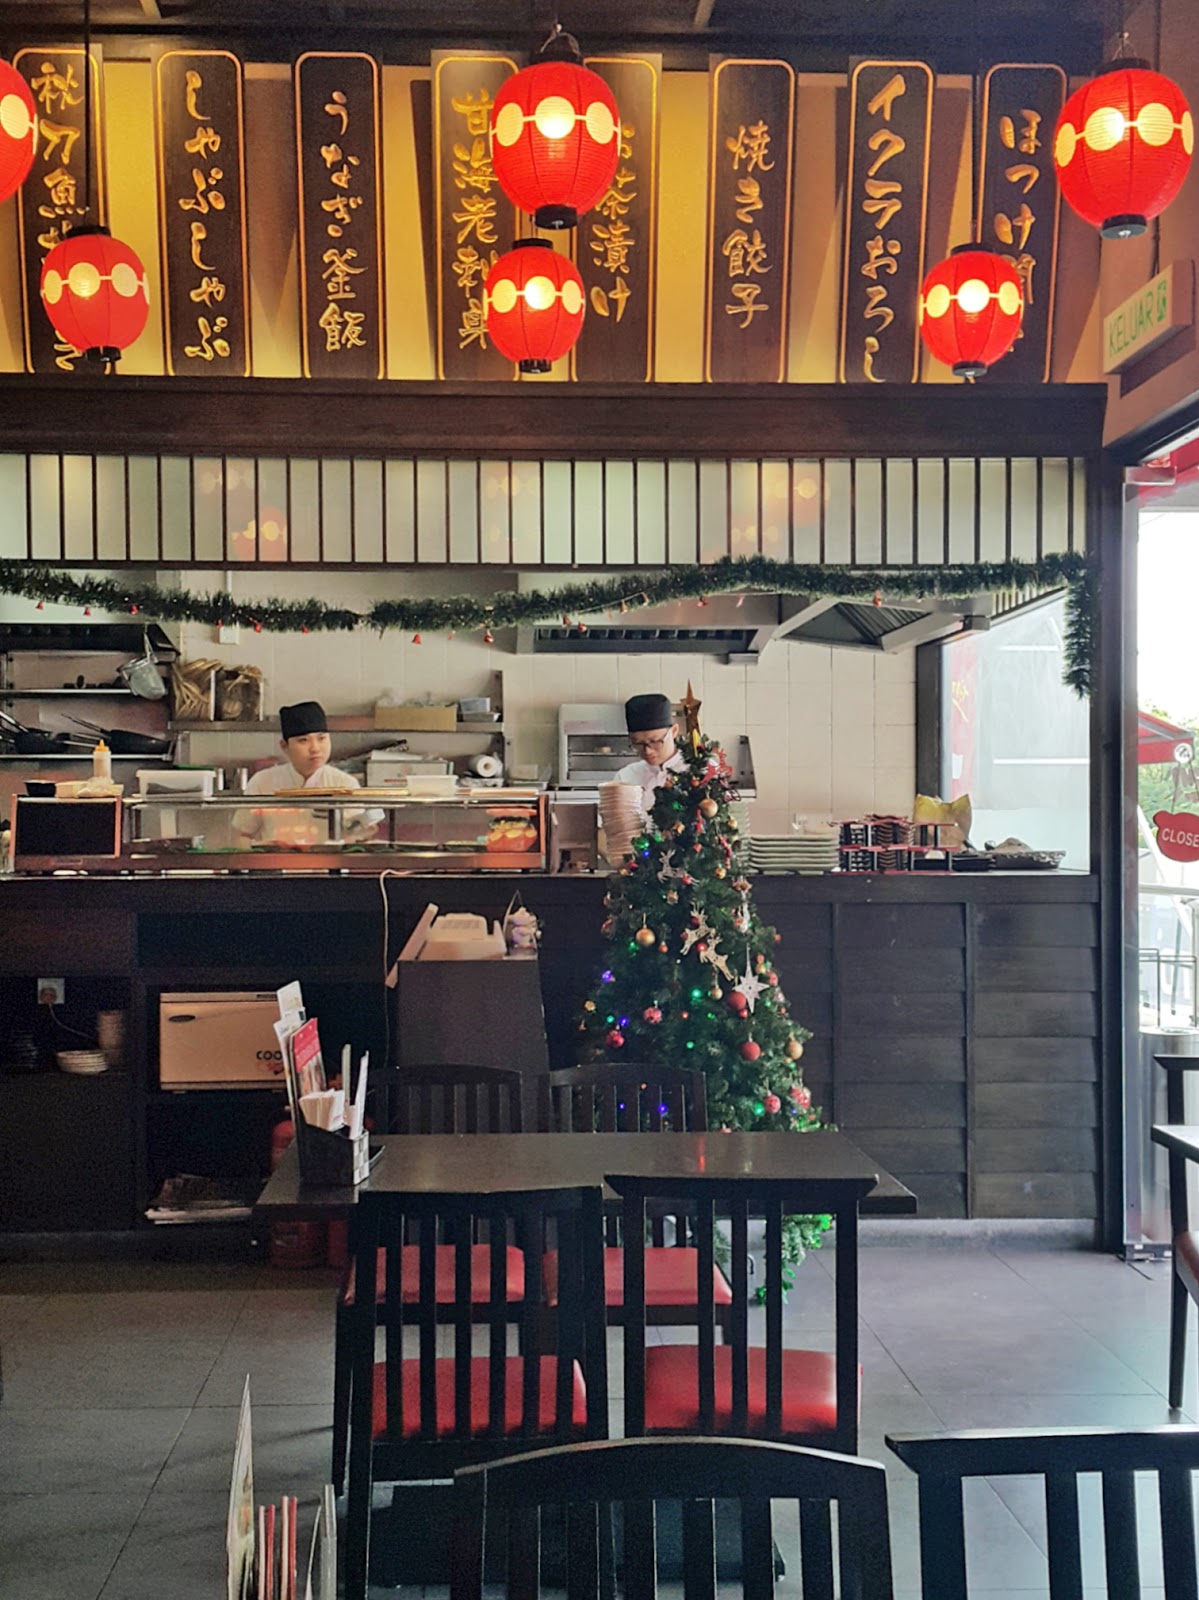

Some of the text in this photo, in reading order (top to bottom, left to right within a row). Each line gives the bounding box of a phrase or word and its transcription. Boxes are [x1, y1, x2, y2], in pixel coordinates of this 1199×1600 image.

[319, 90, 369, 352] うなぎ釜飯
[722, 119, 776, 329] 焼き餃子
[860, 73, 906, 383] イクラおろし
[1107, 290, 1155, 358] KELUAR
